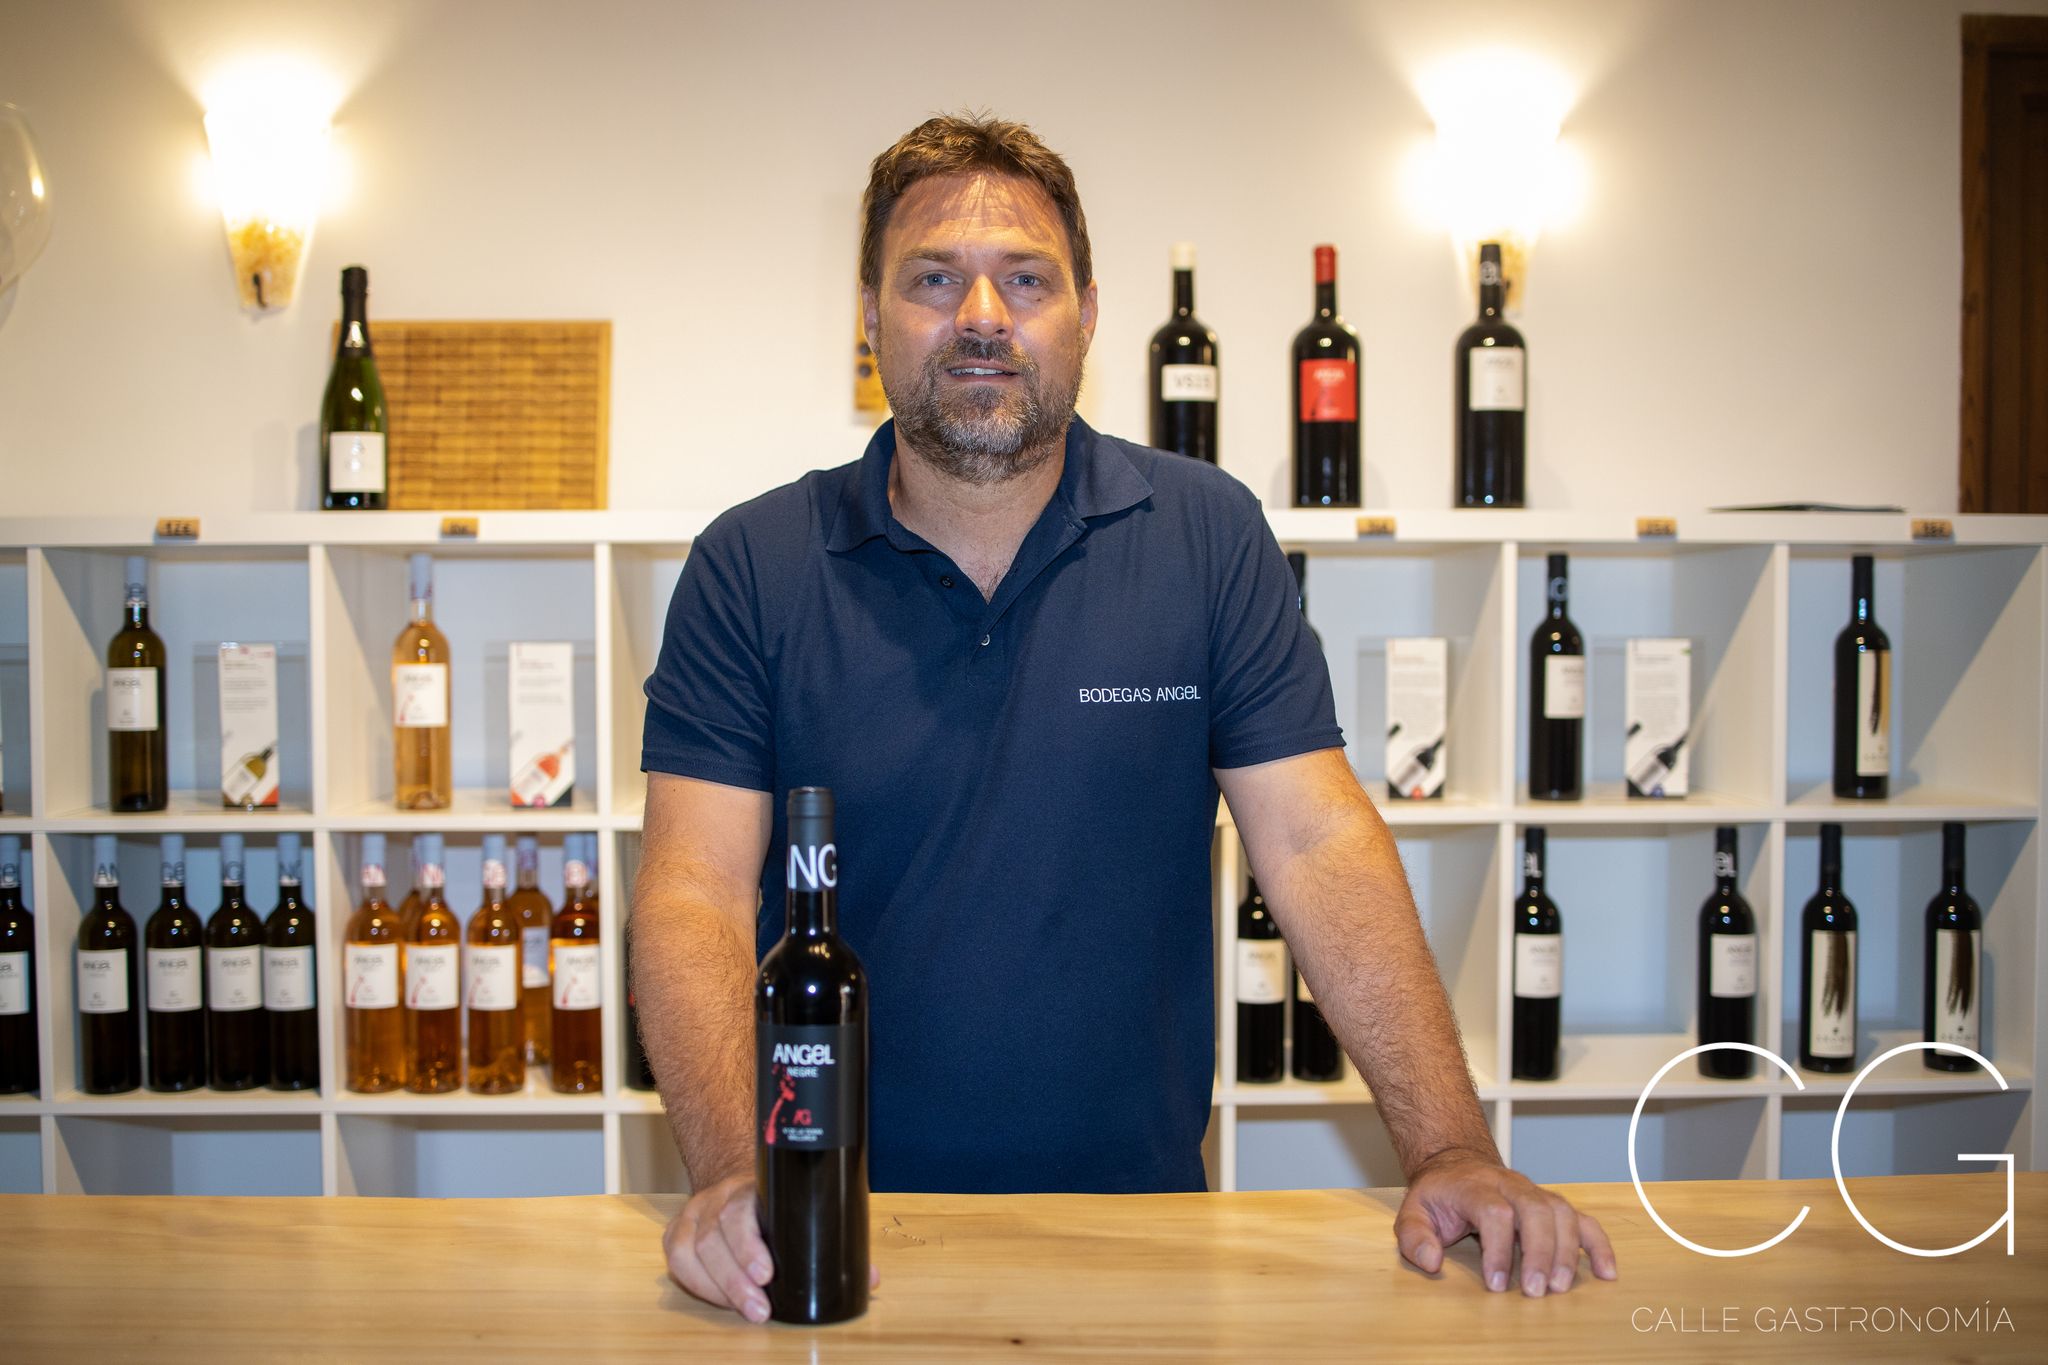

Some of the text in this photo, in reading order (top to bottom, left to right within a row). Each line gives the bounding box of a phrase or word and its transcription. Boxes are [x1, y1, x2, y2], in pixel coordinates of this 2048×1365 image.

[1079, 687, 1151, 703] BODEGAS
[787, 843, 838, 889] NG
[786, 1066, 819, 1078] NEGRE
